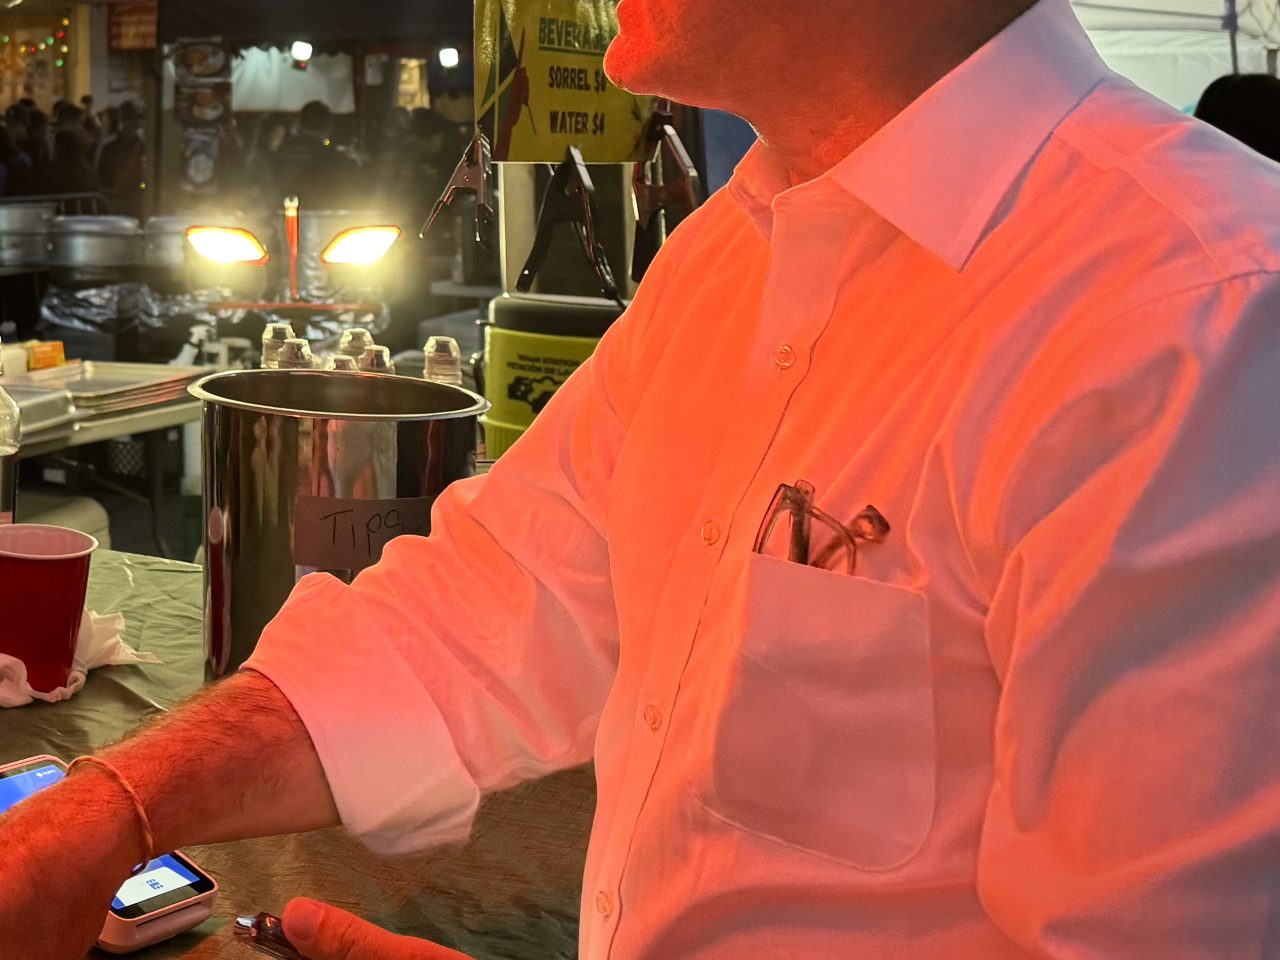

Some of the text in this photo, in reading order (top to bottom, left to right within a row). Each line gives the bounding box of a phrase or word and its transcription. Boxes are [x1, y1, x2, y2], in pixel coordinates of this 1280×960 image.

[548, 66, 591, 91] SORREL
[550, 110, 606, 135] WATER $4
